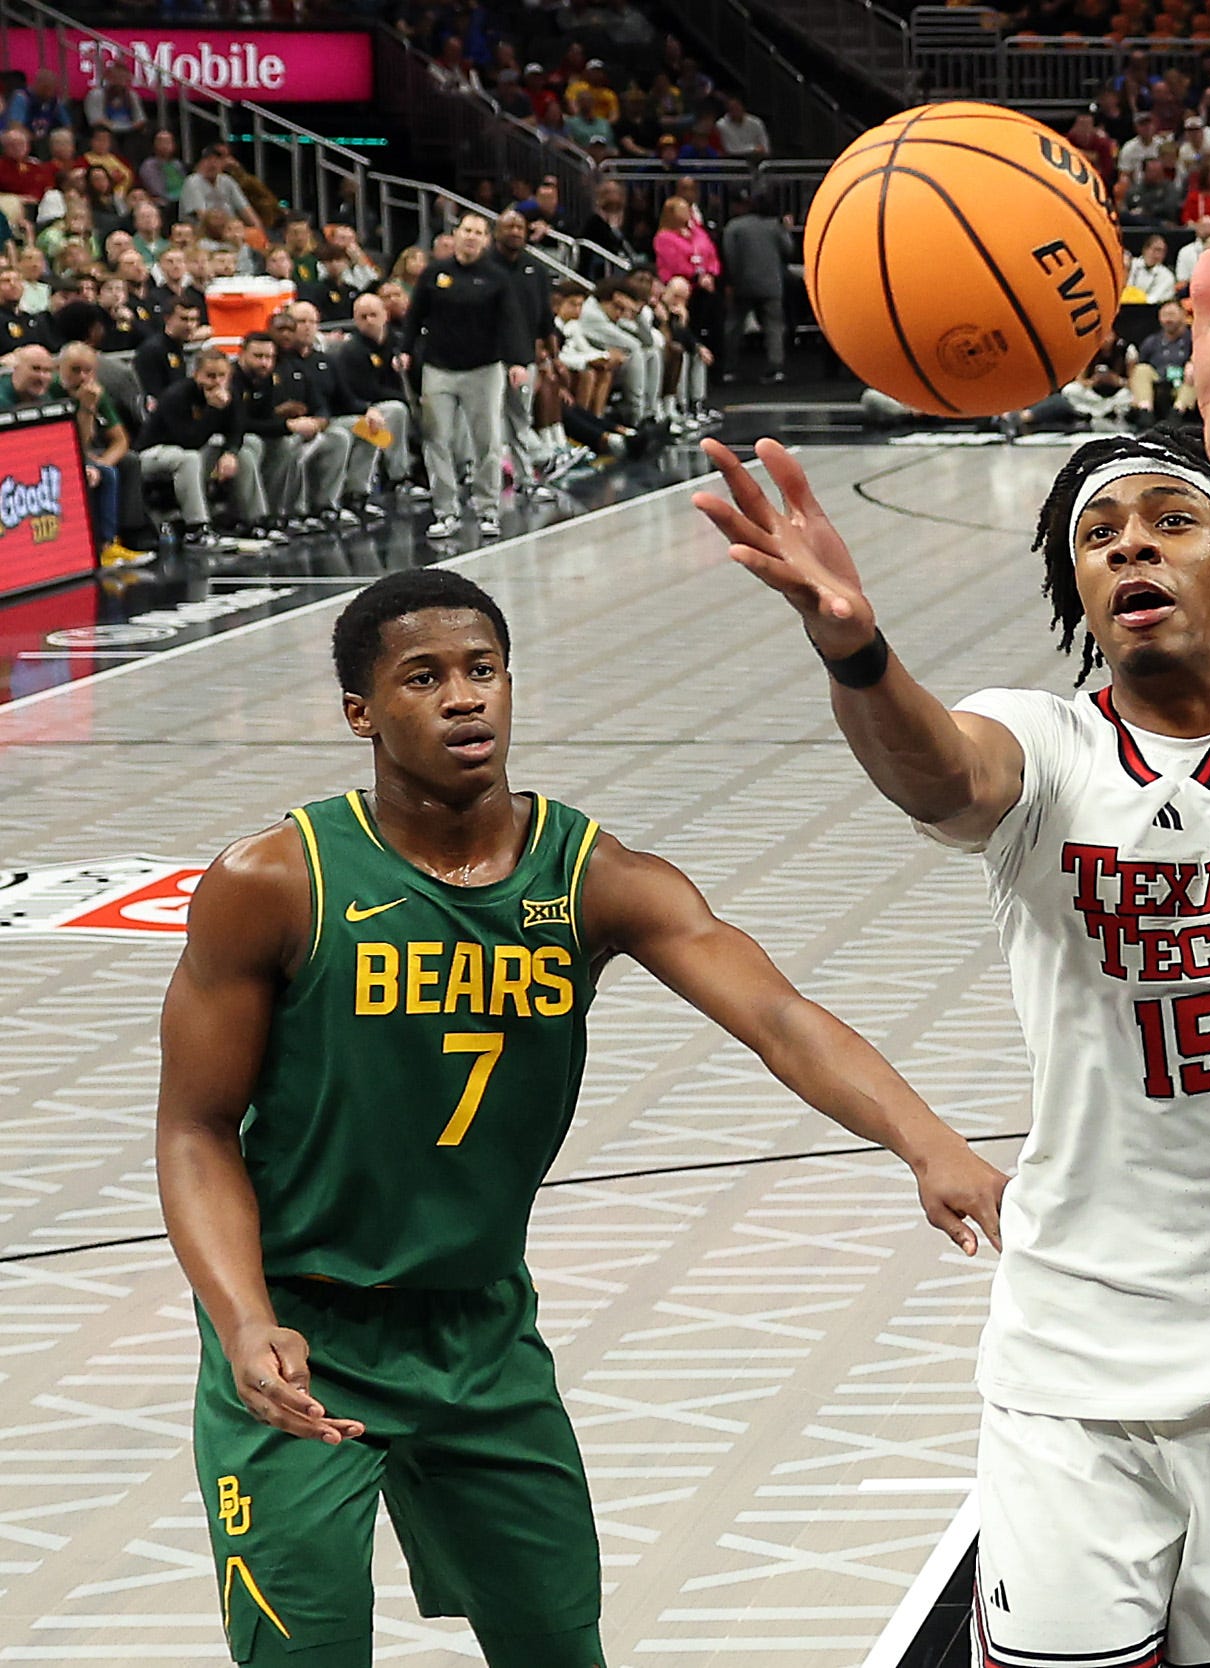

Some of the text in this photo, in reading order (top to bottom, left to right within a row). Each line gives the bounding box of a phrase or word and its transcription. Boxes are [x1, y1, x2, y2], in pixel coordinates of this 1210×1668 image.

[131, 41, 286, 89] Mobile
[1031, 239, 1102, 338] EVO
[355, 941, 574, 1017] BEARS
[436, 1032, 504, 1146] 7
